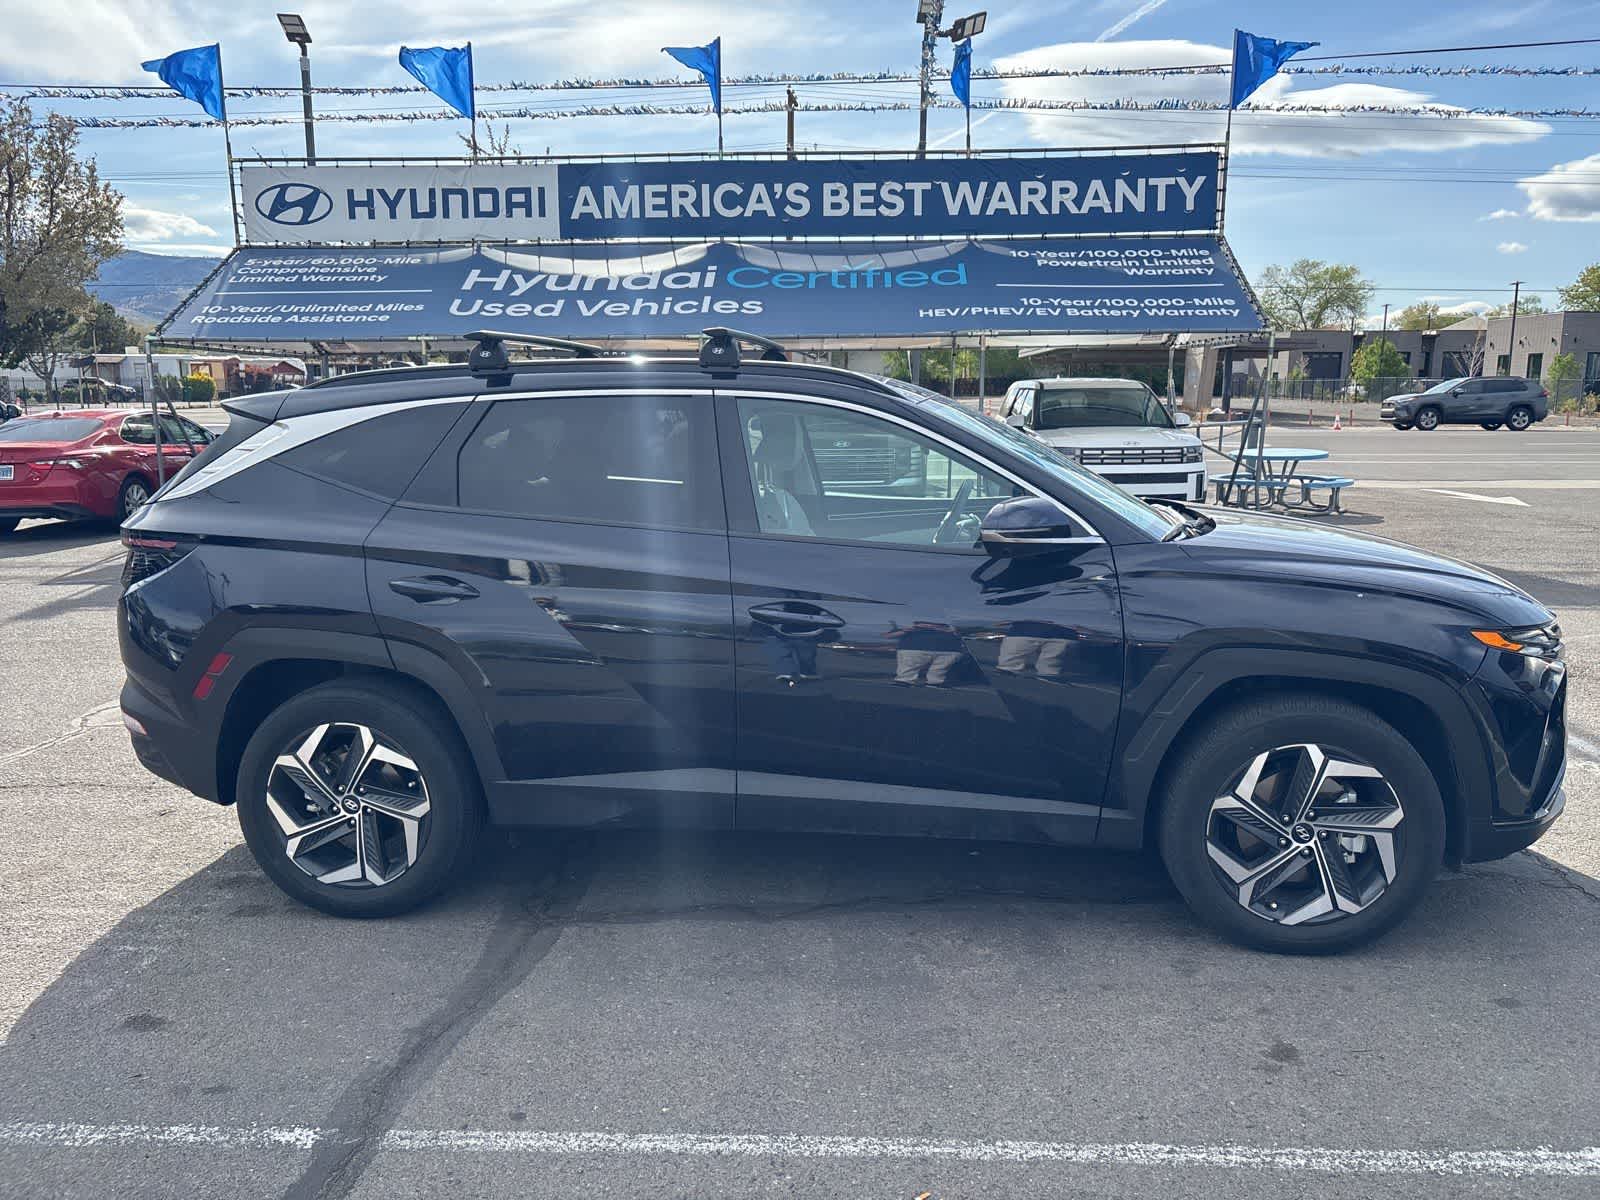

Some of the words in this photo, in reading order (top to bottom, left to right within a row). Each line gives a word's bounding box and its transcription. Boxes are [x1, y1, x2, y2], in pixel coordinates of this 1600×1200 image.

[569, 182, 812, 220] AMERICA'S
[822, 180, 932, 218] BEST
[938, 174, 1207, 216] WARRANTY
[346, 187, 547, 220] HYUNDAI
[1009, 248, 1211, 259] 10-Year/100,000-Mile
[1036, 257, 1140, 268] Powertrain
[1143, 256, 1214, 267] Limited
[1123, 267, 1215, 277] Warranty
[228, 274, 301, 284] Limited
[302, 274, 390, 284] Warranty
[460, 265, 718, 297] Hyundai
[726, 262, 969, 290] Certified
[201, 303, 374, 314] 10-Year/Unlimited
[375, 302, 425, 313] Miles
[448, 297, 566, 318] Used
[576, 295, 765, 317] Vehicles
[1019, 297, 1236, 308] 10-Year/100,000-Mile
[918, 307, 1063, 318] HEV/PHEV/EV
[1066, 306, 1140, 318] Battery
[1142, 306, 1240, 318] Warranty
[190, 314, 283, 325] Roadside
[284, 313, 391, 324] Assistance
